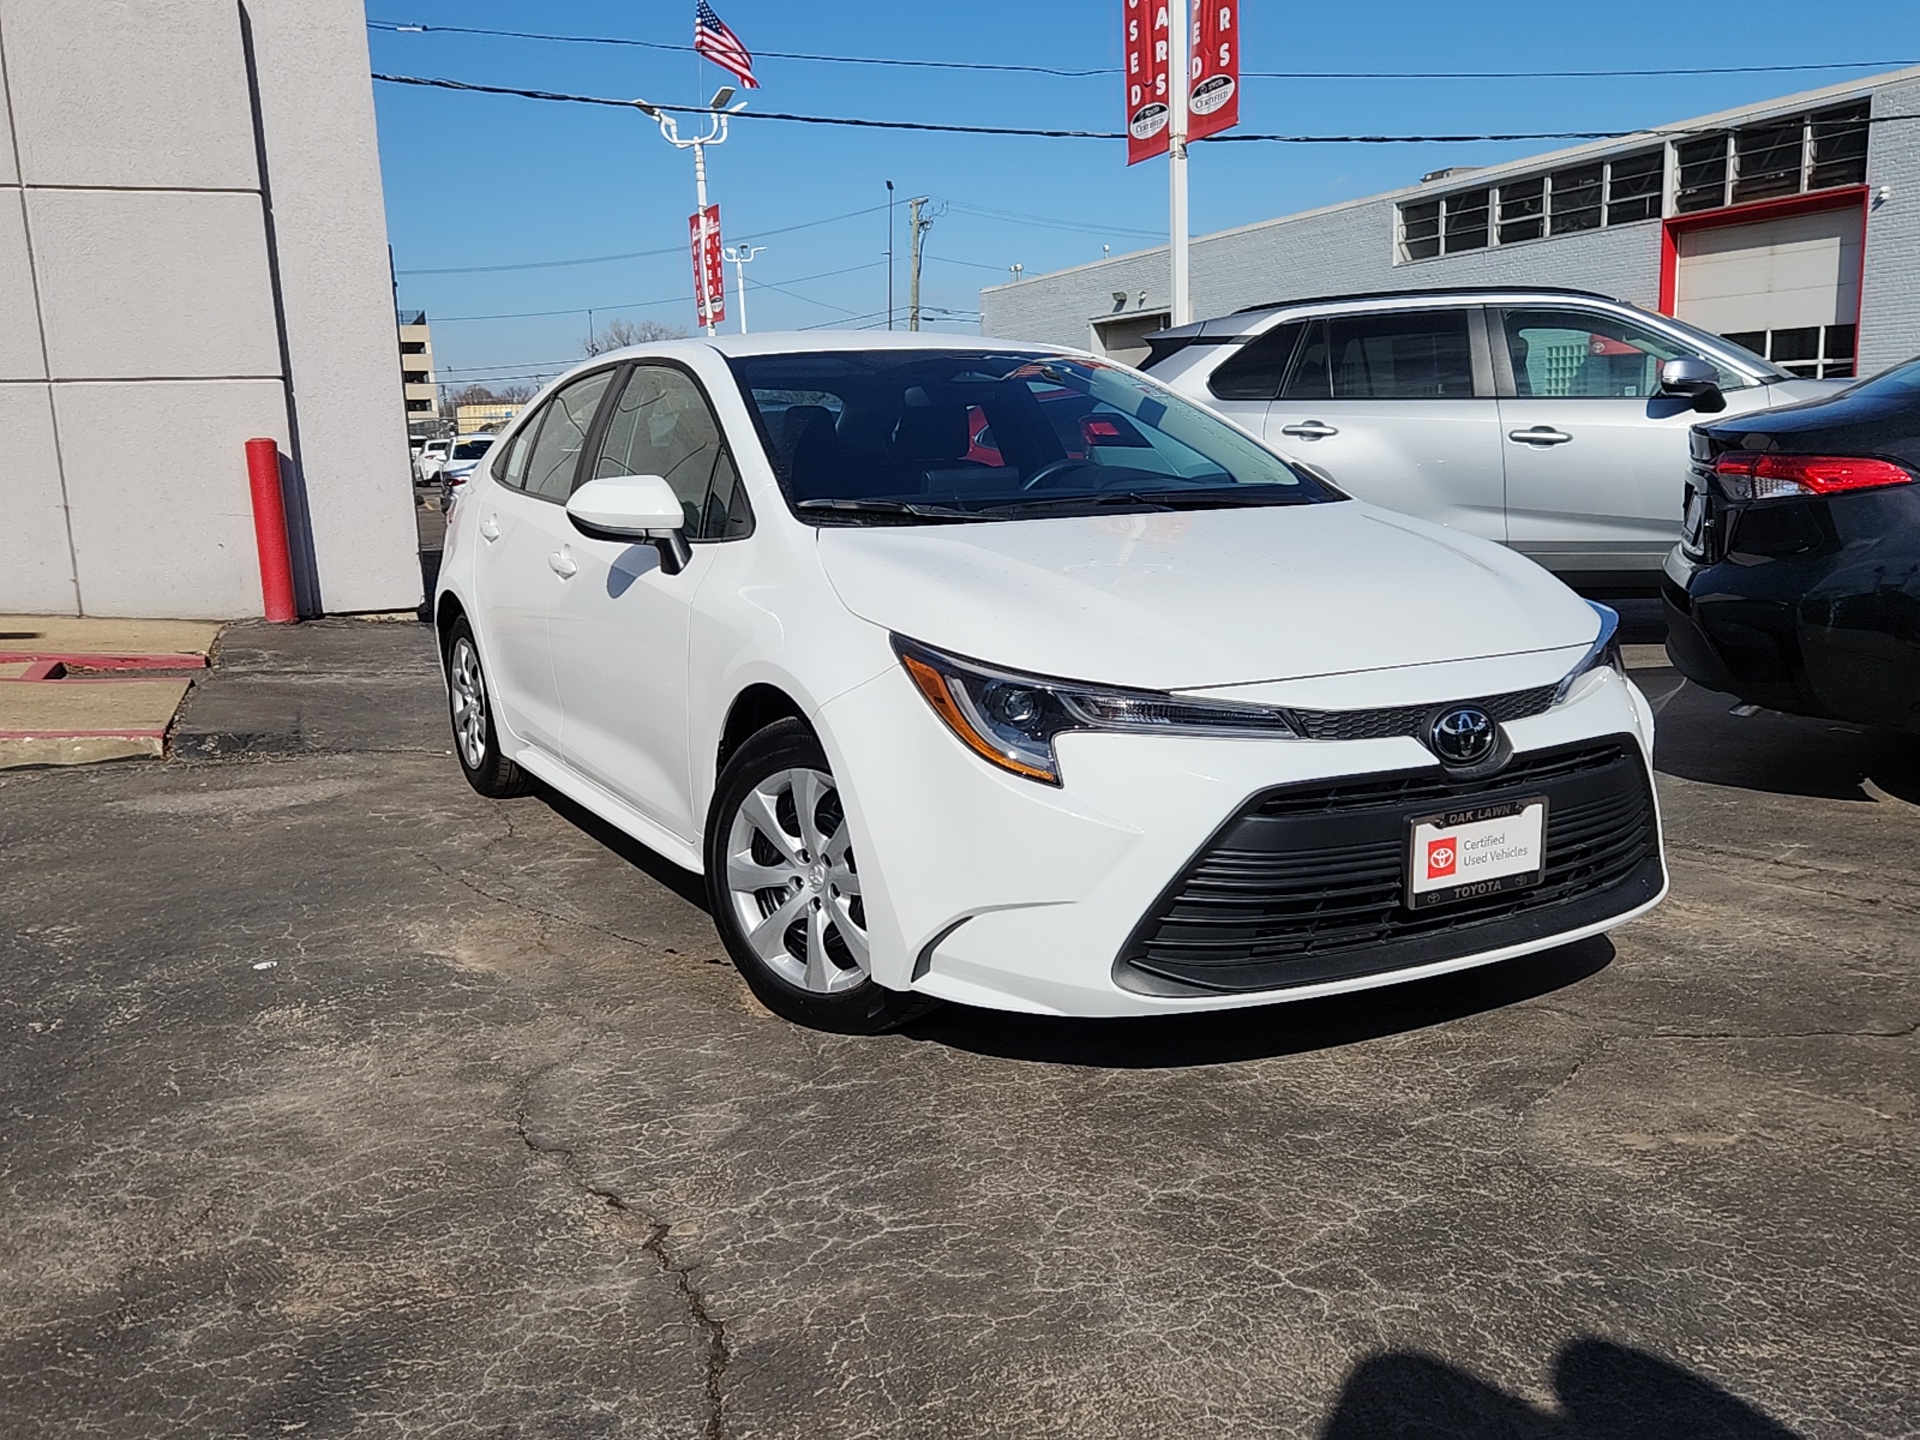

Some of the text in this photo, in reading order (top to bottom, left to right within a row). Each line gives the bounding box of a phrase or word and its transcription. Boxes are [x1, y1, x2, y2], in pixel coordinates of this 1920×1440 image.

[1449, 803, 1511, 824] OAK LAWN
[1463, 832, 1506, 851] Certified
[1463, 846, 1528, 867] Used Vehicles
[1453, 879, 1502, 899] TOYOTA
